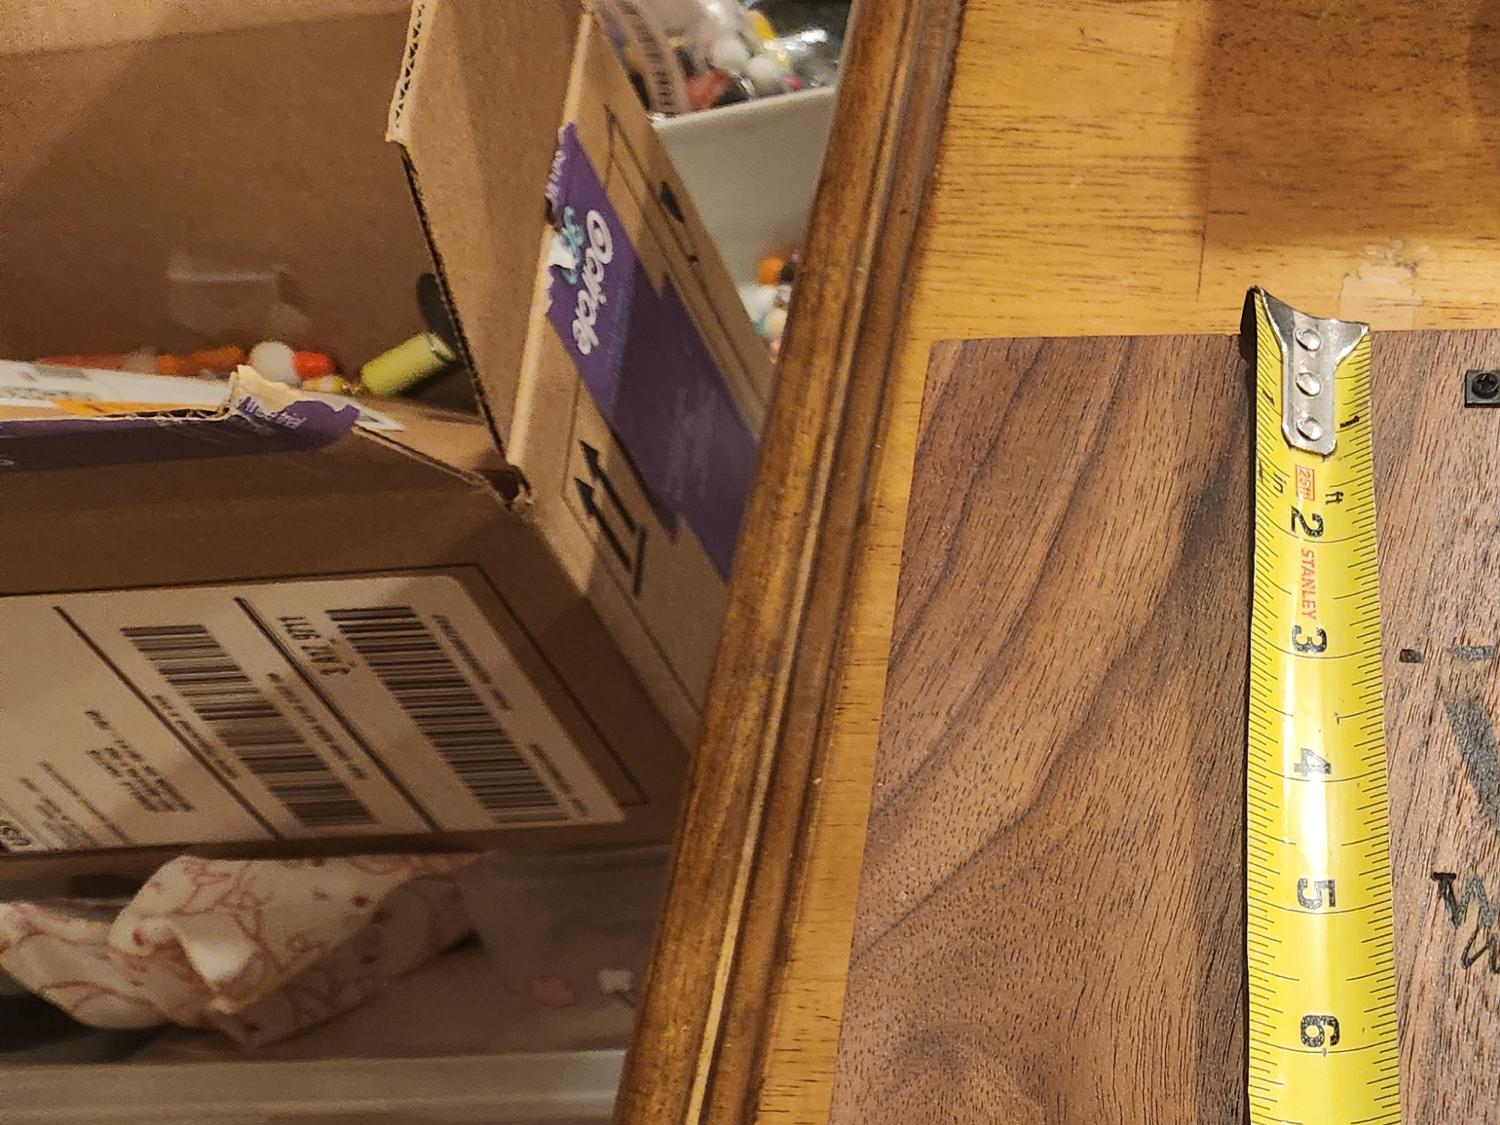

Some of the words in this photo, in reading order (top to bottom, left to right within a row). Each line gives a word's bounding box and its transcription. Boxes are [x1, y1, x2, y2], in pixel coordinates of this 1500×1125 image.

[1291, 506, 1324, 538] 2
[1301, 548, 1317, 620] STANLEY
[1292, 624, 1327, 653] 3
[1294, 747, 1331, 777] 4
[1297, 878, 1335, 909] 5
[1300, 1014, 1340, 1048] 6
